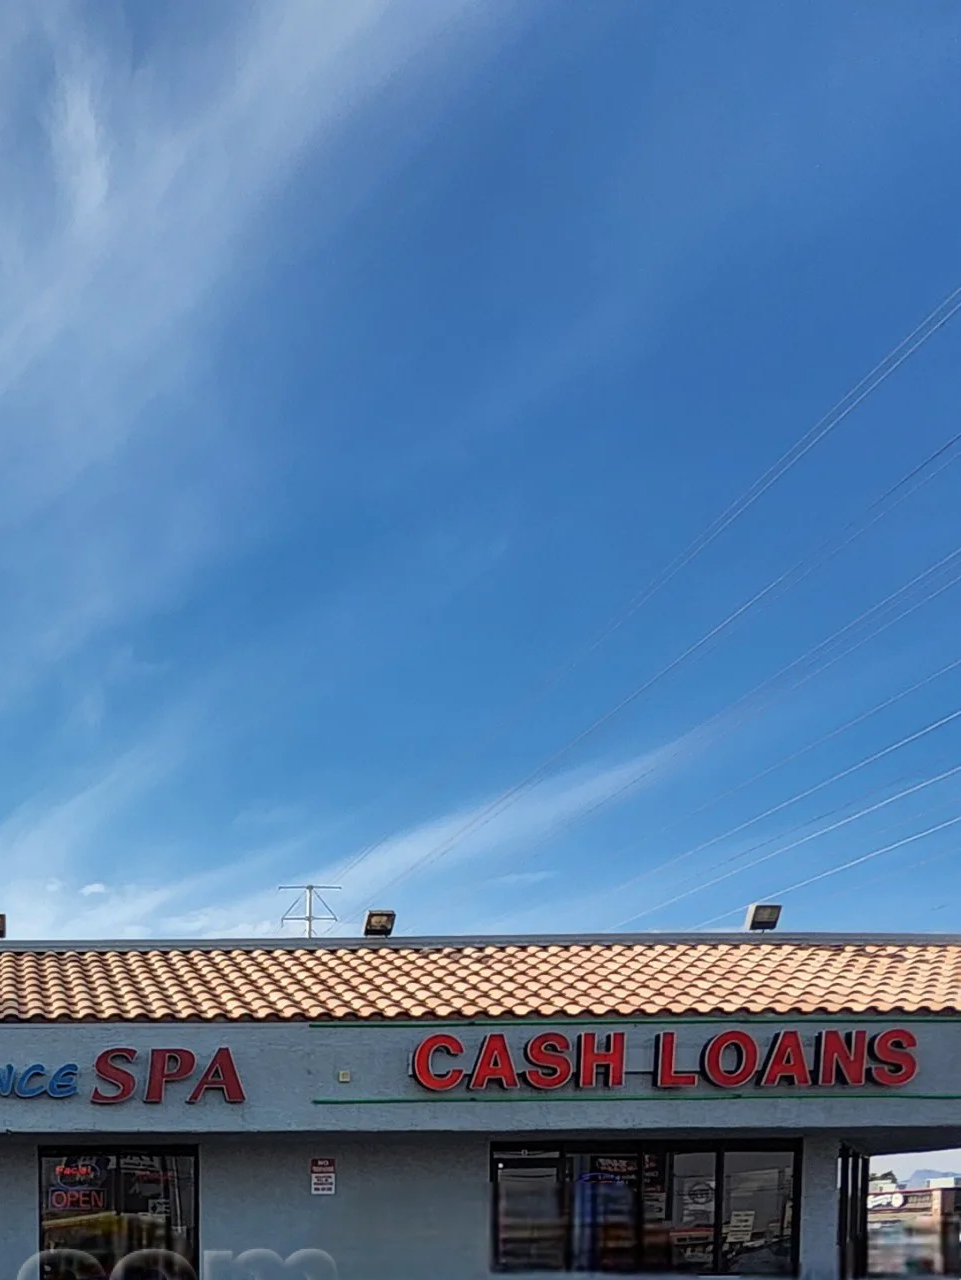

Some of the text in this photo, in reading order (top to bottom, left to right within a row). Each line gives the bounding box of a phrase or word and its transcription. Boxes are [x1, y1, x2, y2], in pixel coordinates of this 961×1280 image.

[90, 1046, 246, 1105] SPA
[413, 1028, 919, 1091] CASH LOANS
[51, 1190, 105, 1209] OPEN
